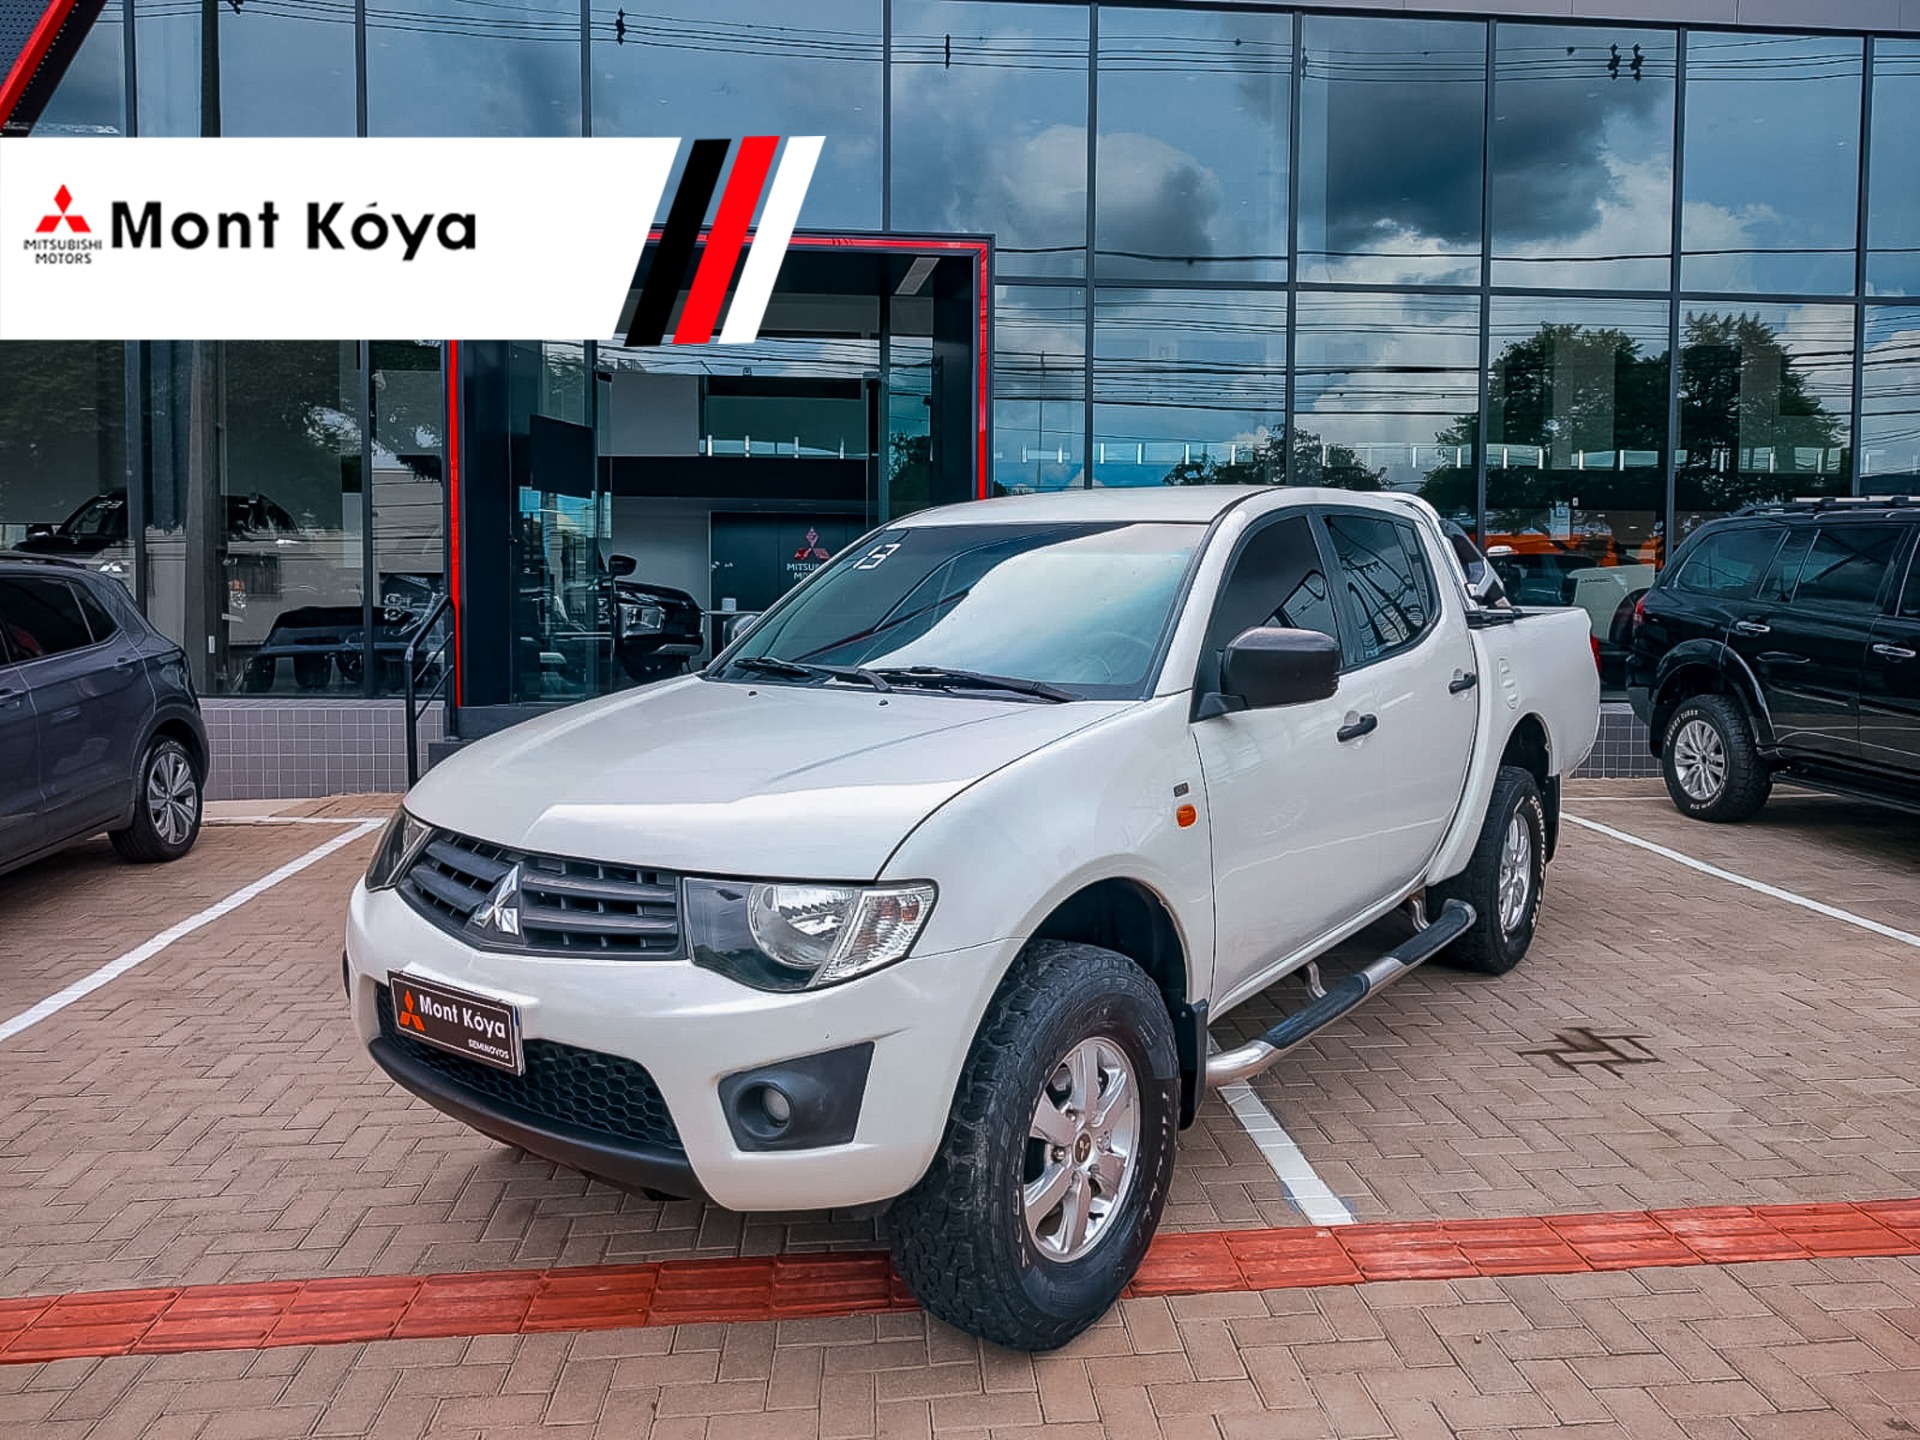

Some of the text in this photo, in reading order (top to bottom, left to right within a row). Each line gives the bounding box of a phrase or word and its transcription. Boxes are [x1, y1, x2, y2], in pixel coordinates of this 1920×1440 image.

[418, 994, 506, 1039] Mont Kóya
[468, 1039, 509, 1059] SEMINOVOS
